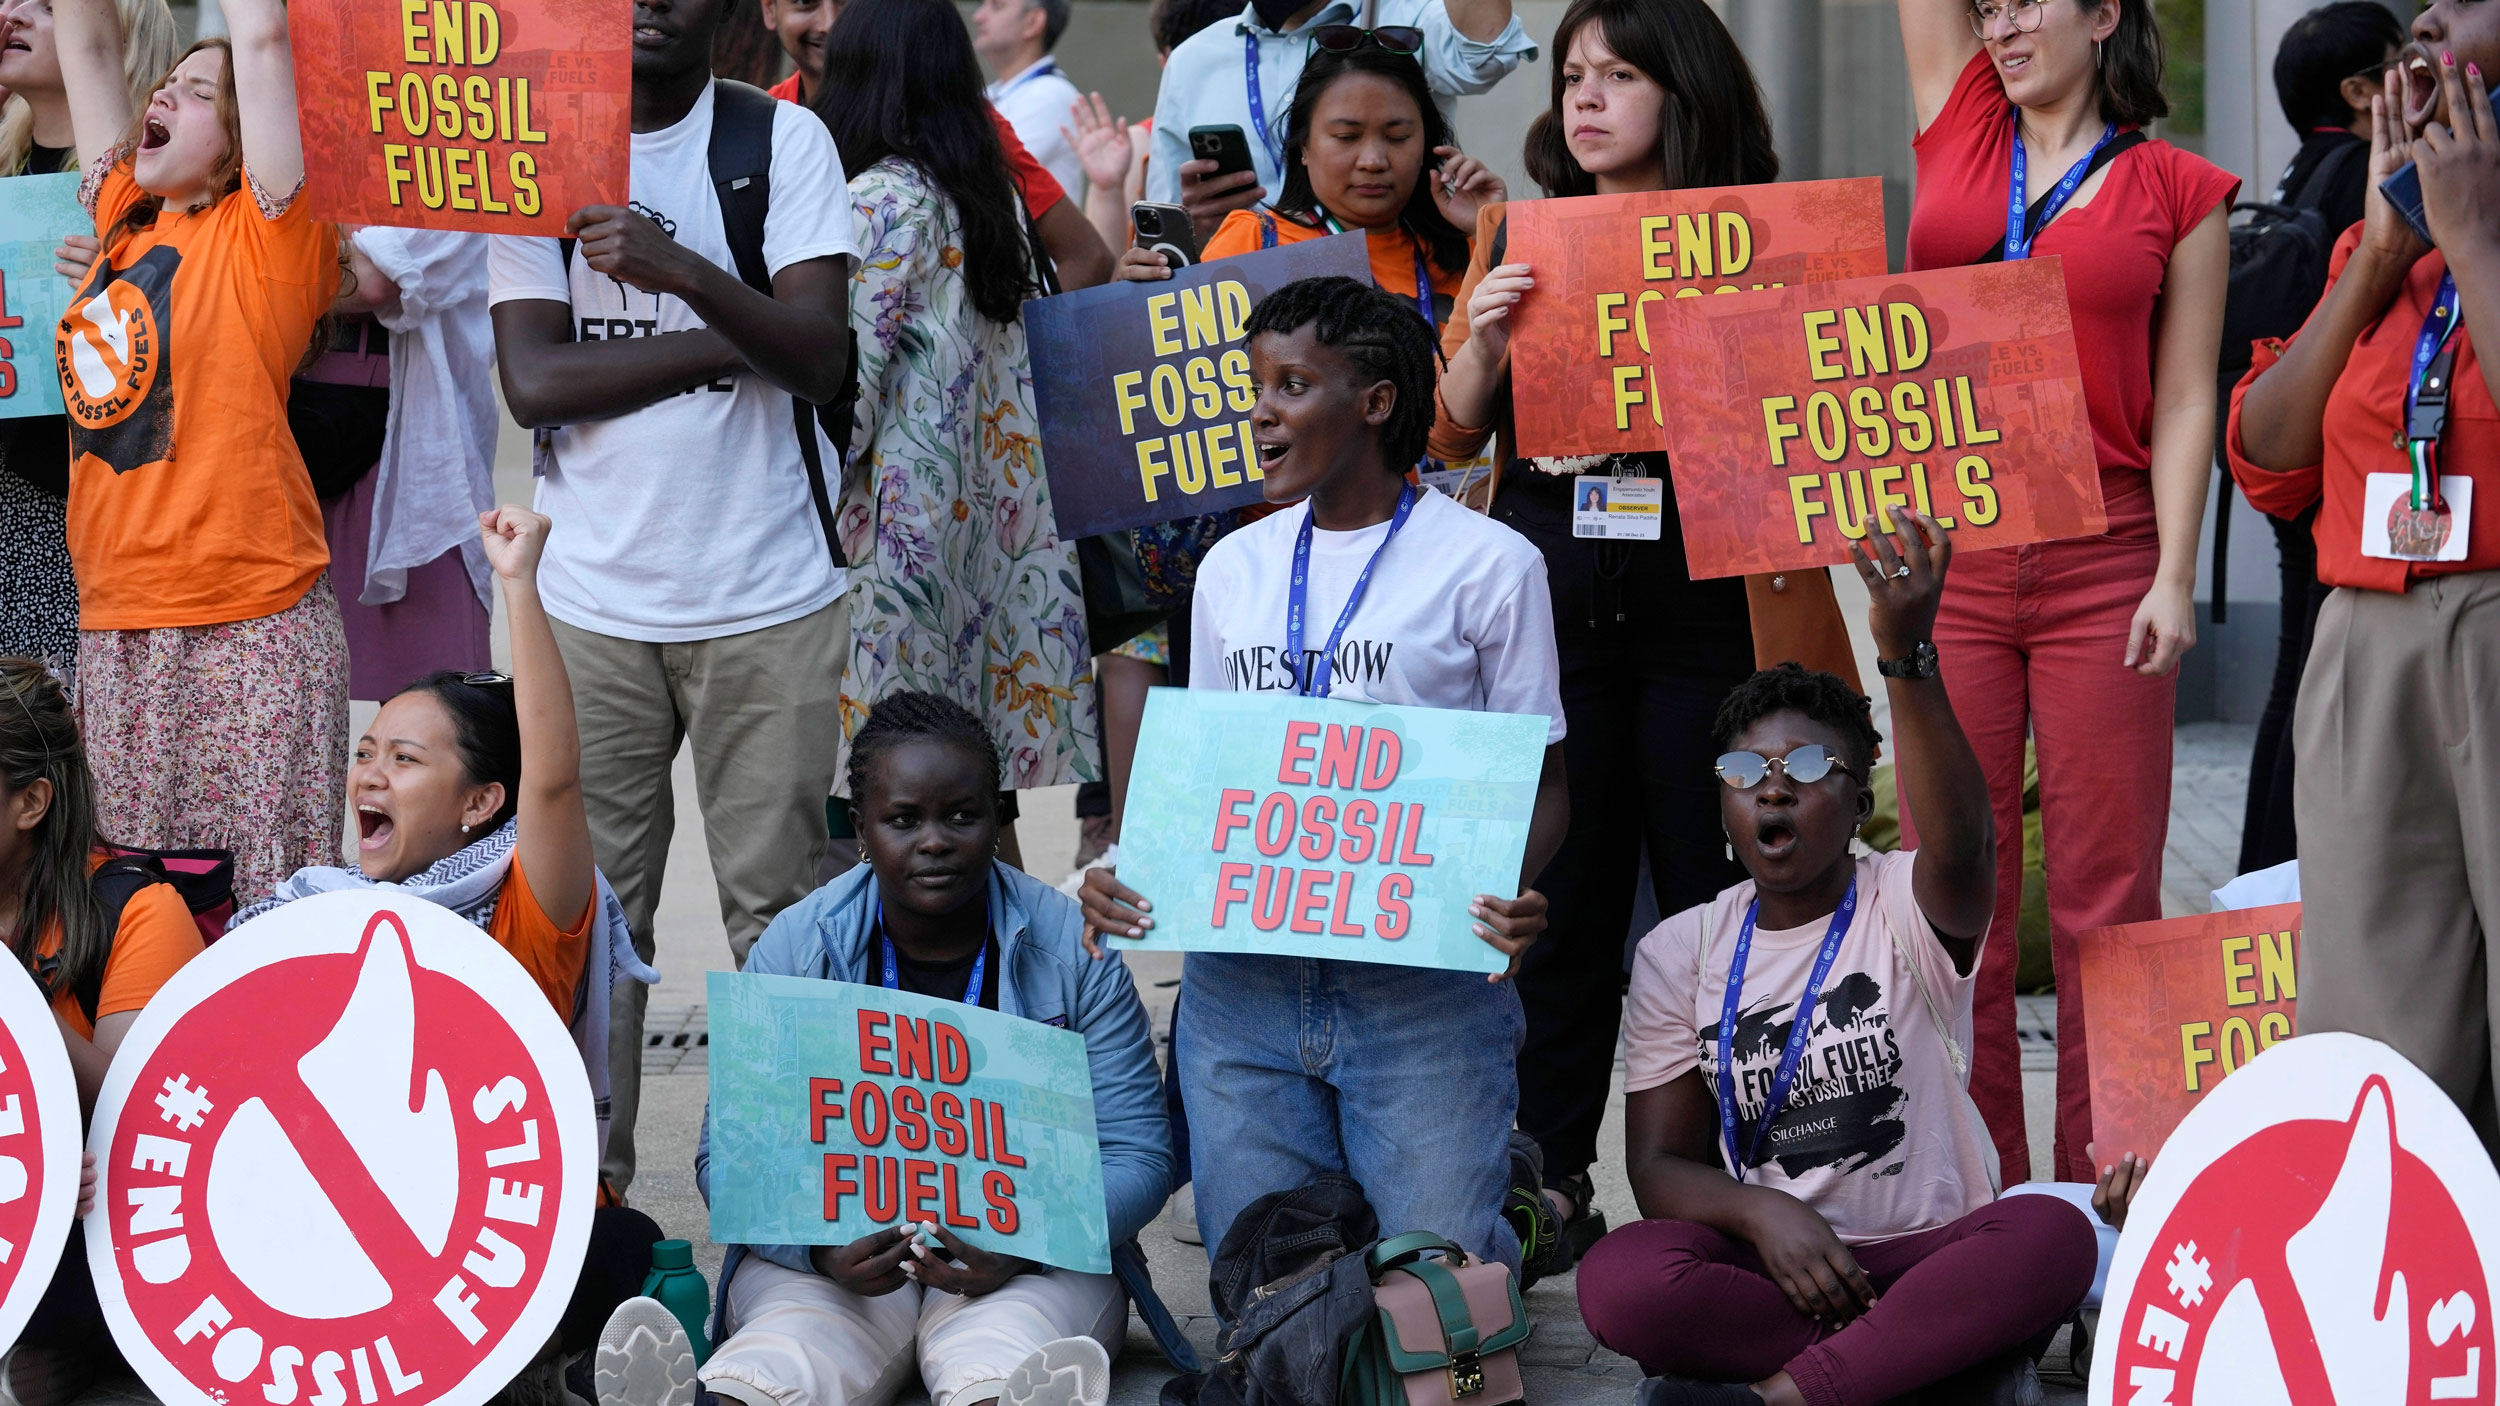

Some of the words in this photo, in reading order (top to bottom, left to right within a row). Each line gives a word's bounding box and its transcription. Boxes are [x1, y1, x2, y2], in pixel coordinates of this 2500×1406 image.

[402, 0, 499, 65] END
[366, 70, 547, 143] FOSSIL
[550, 71, 597, 84] FUELS
[384, 144, 541, 216] FUELS
[1640, 211, 1752, 281] END
[1830, 256, 1853, 270] VS.
[1147, 280, 1252, 357] END
[1802, 302, 1930, 381] END
[2017, 344, 2042, 358] VS.
[70, 391, 131, 420] FOSSIL
[127, 307, 149, 391] FUELS
[1113, 350, 1257, 435] FOSS
[1992, 358, 2045, 379] FUELS
[1762, 375, 2000, 466] FOSSIL
[1136, 420, 1265, 502] FUEL
[1788, 455, 1998, 544] FUELS
[1225, 645, 1324, 694] DIVEST
[1329, 639, 1394, 685] NOW
[1277, 720, 1402, 791] END
[1211, 788, 1434, 866] FOSSIL
[1211, 862, 1414, 940] FUELS
[2221, 930, 2300, 1007] EN
[857, 1008, 969, 1084] END
[1823, 1028, 1901, 1080] FUELS
[809, 1076, 1025, 1168] FOSSIL
[1788, 1089, 1806, 1109] IS
[1805, 1077, 1854, 1105] FOSSIL
[1856, 1064, 1894, 1093] FREE
[1770, 1116, 1838, 1142] OILCHANGE
[823, 1153, 1019, 1235] FUELS
[173, 1294, 423, 1406] FOSSIL
[432, 1075, 545, 1346] FUELS
[2127, 1239, 2214, 1406] #EN
